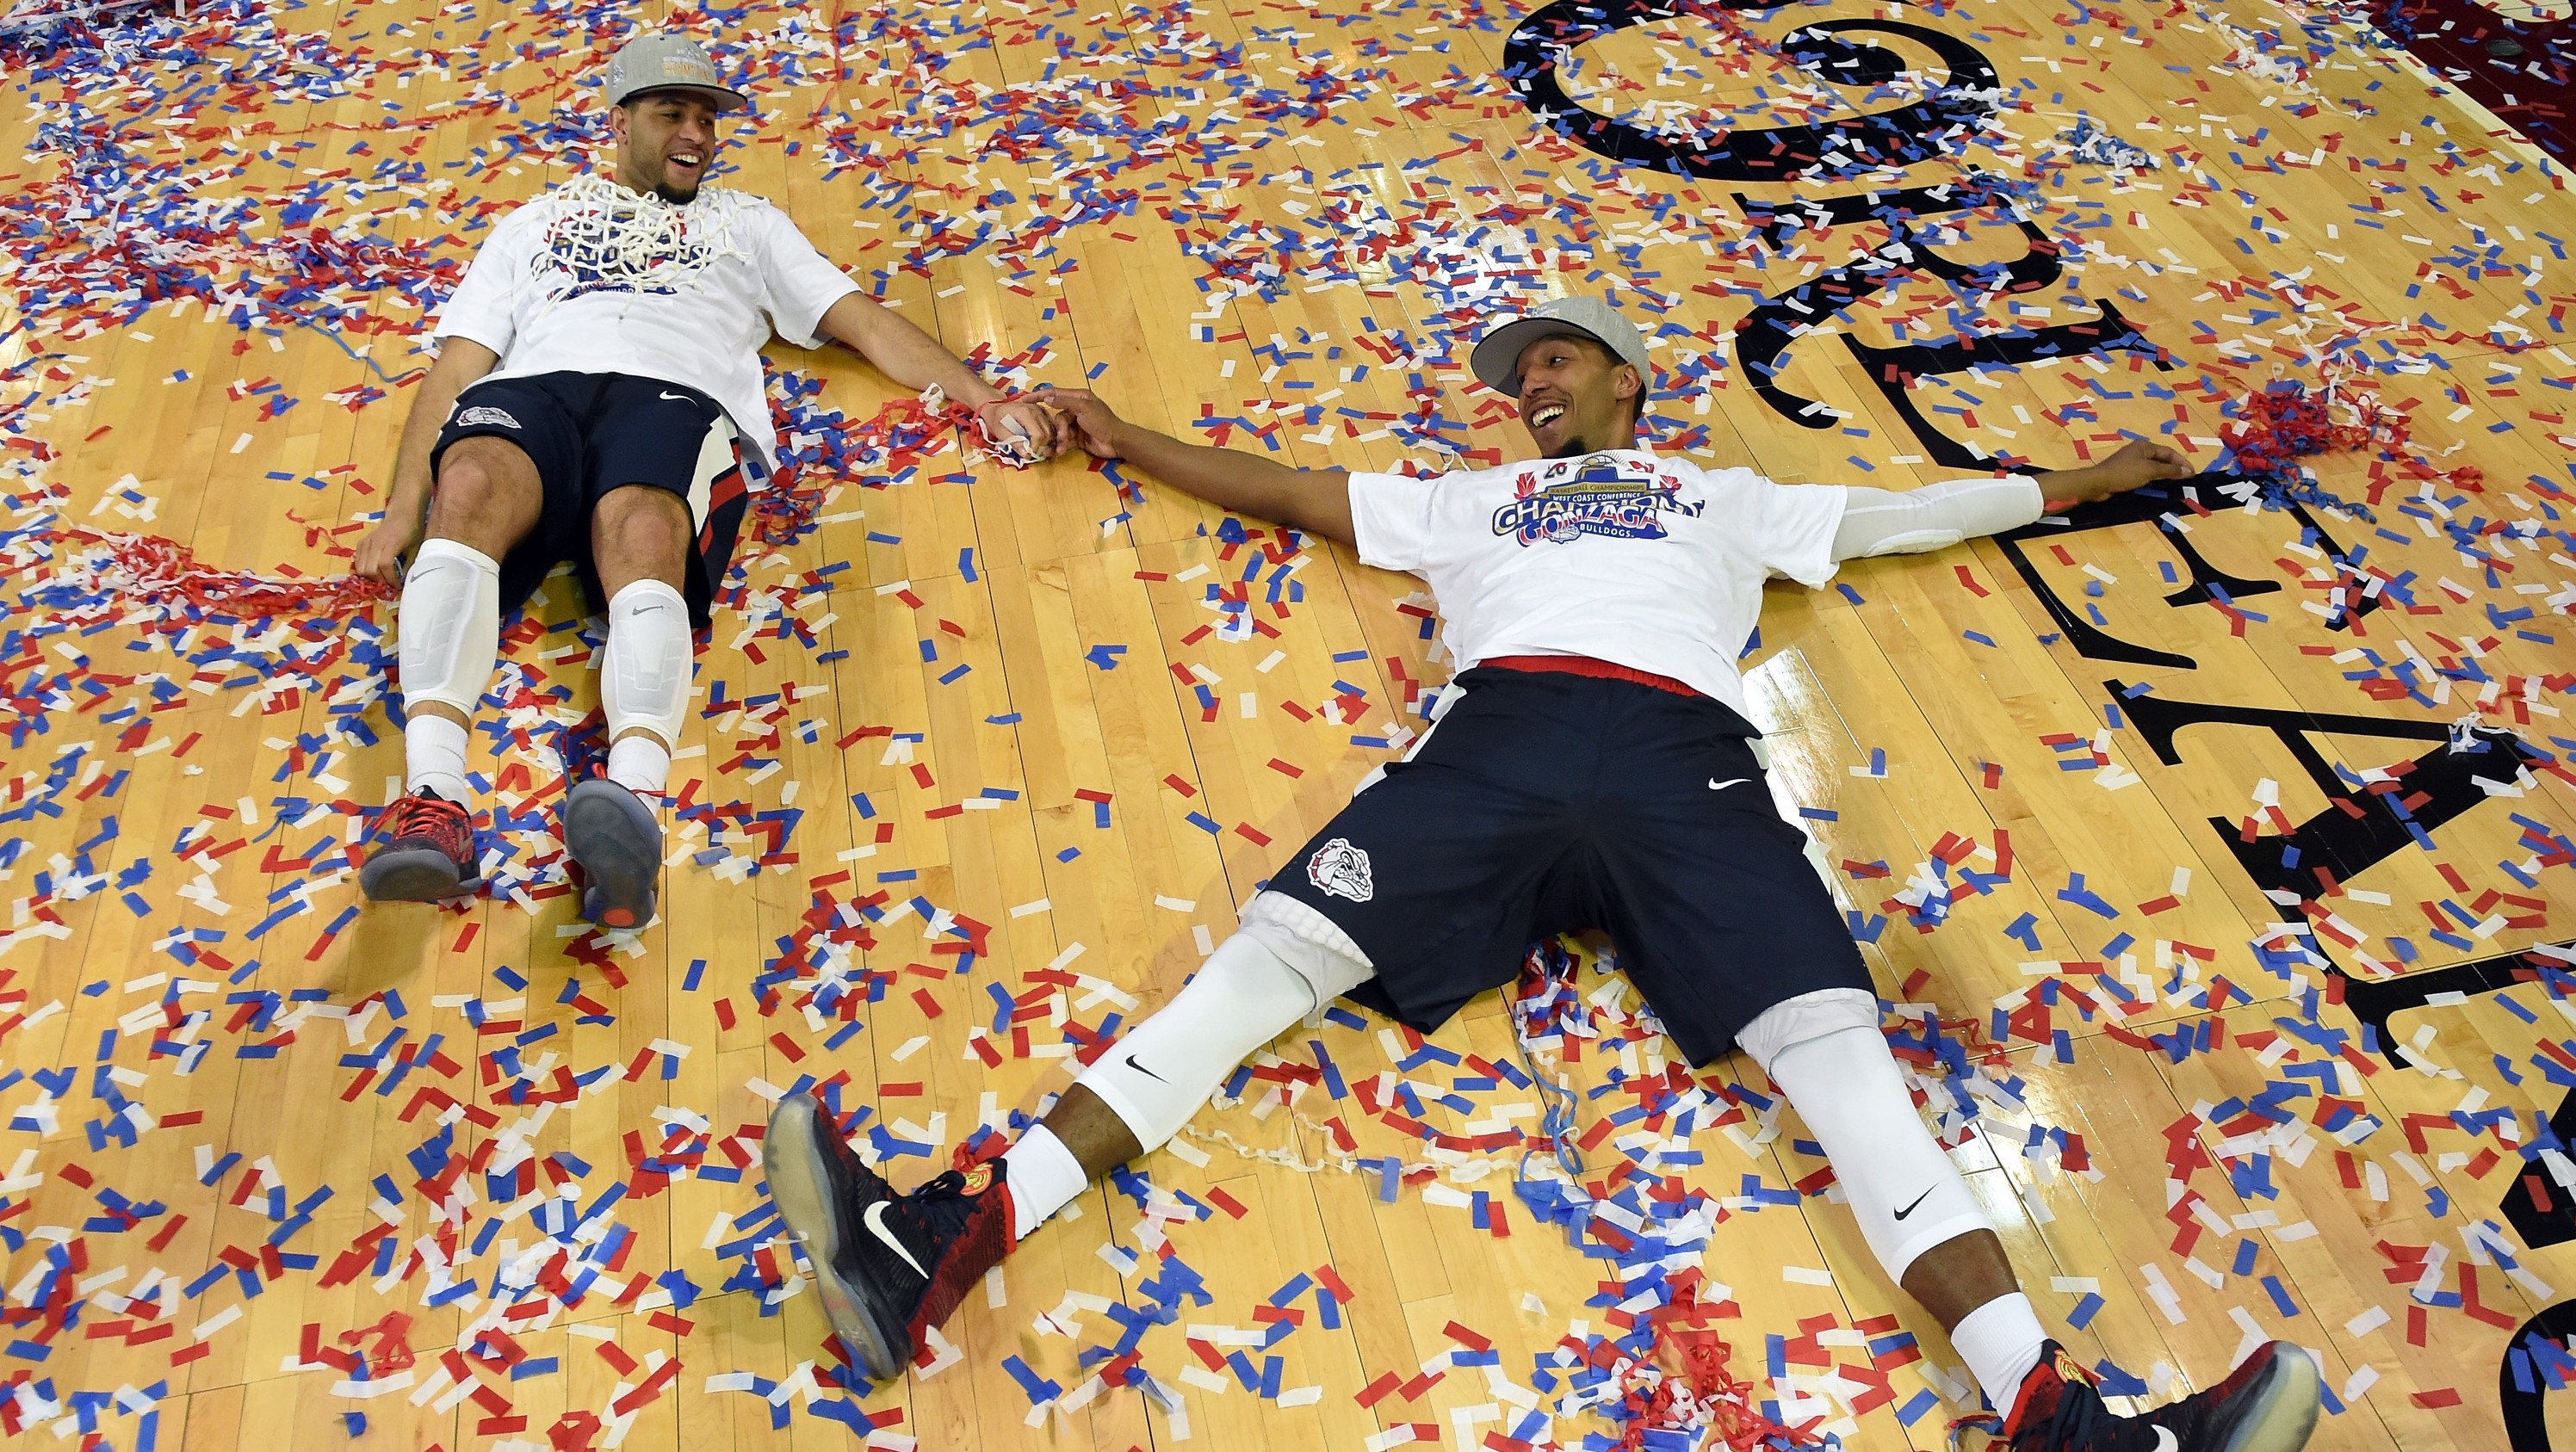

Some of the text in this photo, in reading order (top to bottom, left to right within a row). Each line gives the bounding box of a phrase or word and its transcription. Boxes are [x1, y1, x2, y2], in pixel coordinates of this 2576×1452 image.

[1550, 482, 1645, 495] BASKETBALL CHAMPIONSHIPS
[1572, 493, 1595, 502] COAST
[1596, 492, 1642, 501] CONFERENCE
[1519, 503, 1666, 546] GONZAGA
[1580, 523, 1631, 538] BULLDOGS
[1503, 0, 2576, 1452] ORLEA
